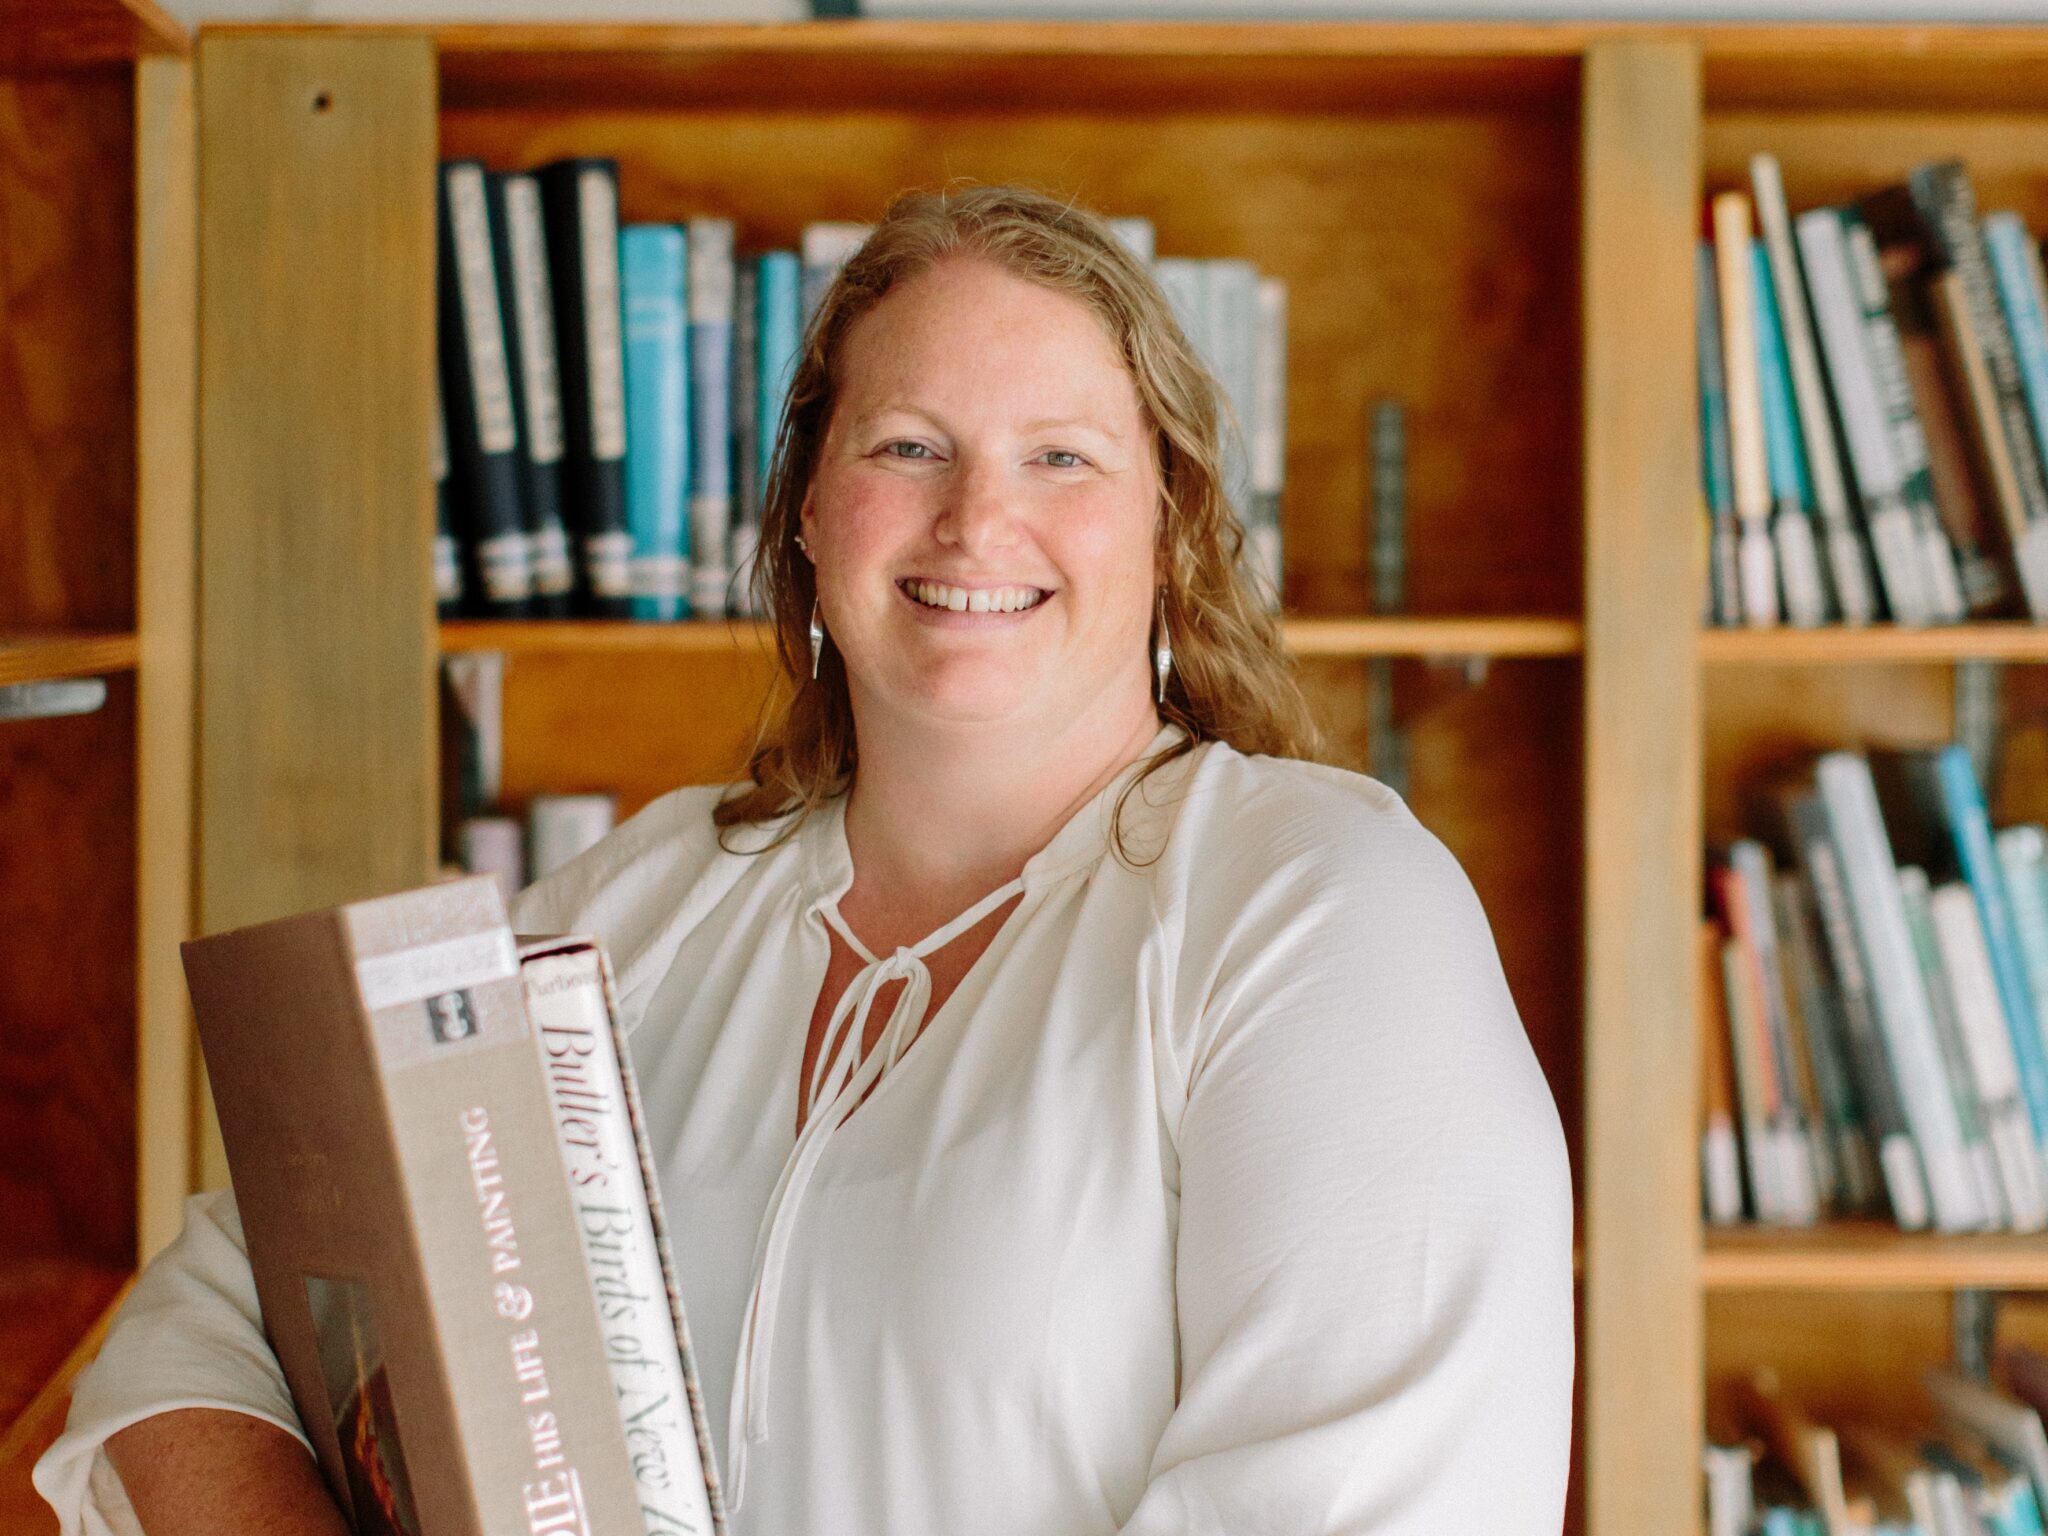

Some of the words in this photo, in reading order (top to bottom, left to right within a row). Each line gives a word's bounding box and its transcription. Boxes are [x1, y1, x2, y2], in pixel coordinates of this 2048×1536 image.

[541, 1025, 618, 1187] Buller's
[460, 1106, 521, 1273] PAINTING
[580, 1204, 649, 1320] Birds
[495, 1281, 533, 1320] &
[511, 1328, 550, 1403] LIFE
[607, 1334, 664, 1373] of
[528, 1411, 564, 1469] HIS
[617, 1384, 677, 1489] New
[522, 1471, 578, 1536] IE
